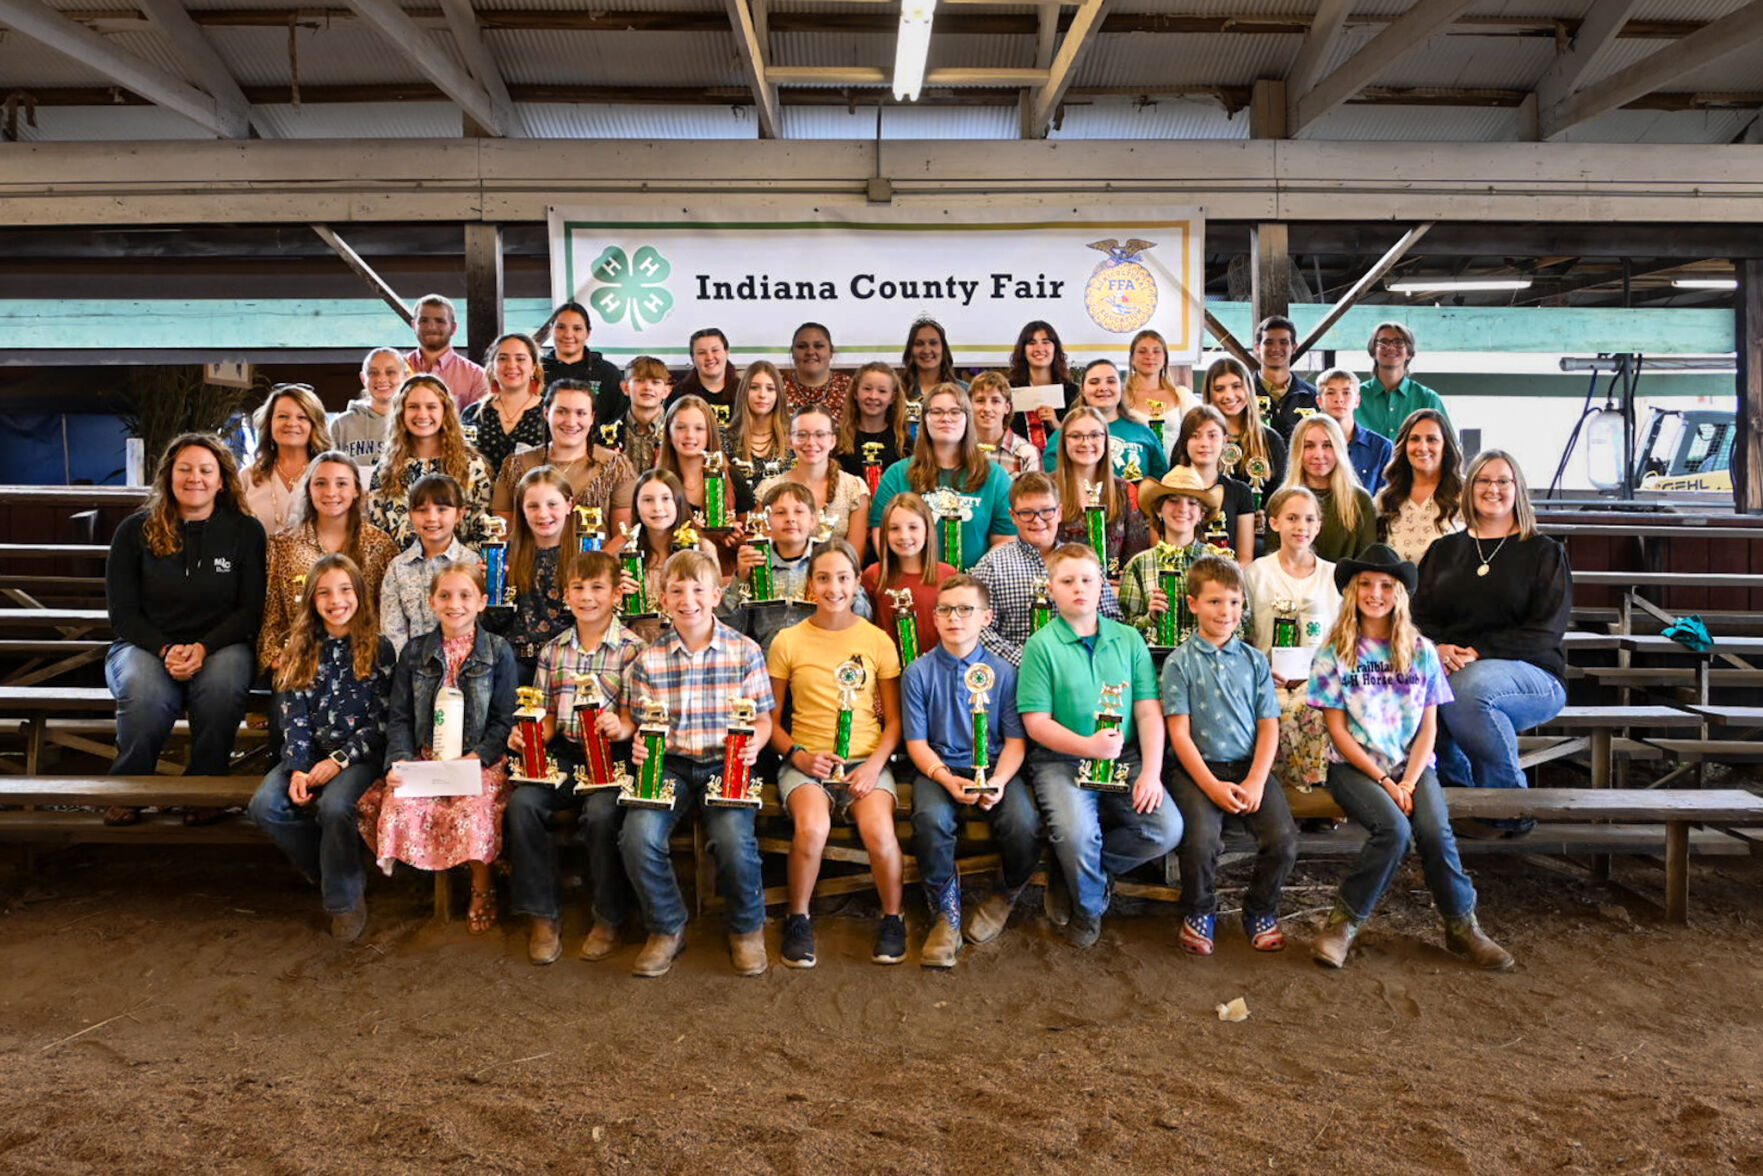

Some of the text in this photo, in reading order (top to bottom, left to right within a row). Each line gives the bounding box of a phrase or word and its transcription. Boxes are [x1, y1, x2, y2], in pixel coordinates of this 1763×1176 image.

[695, 273, 1064, 306] Indiana County Fair
[1108, 279, 1135, 290] FFA
[1363, 673, 1393, 686] Horse
